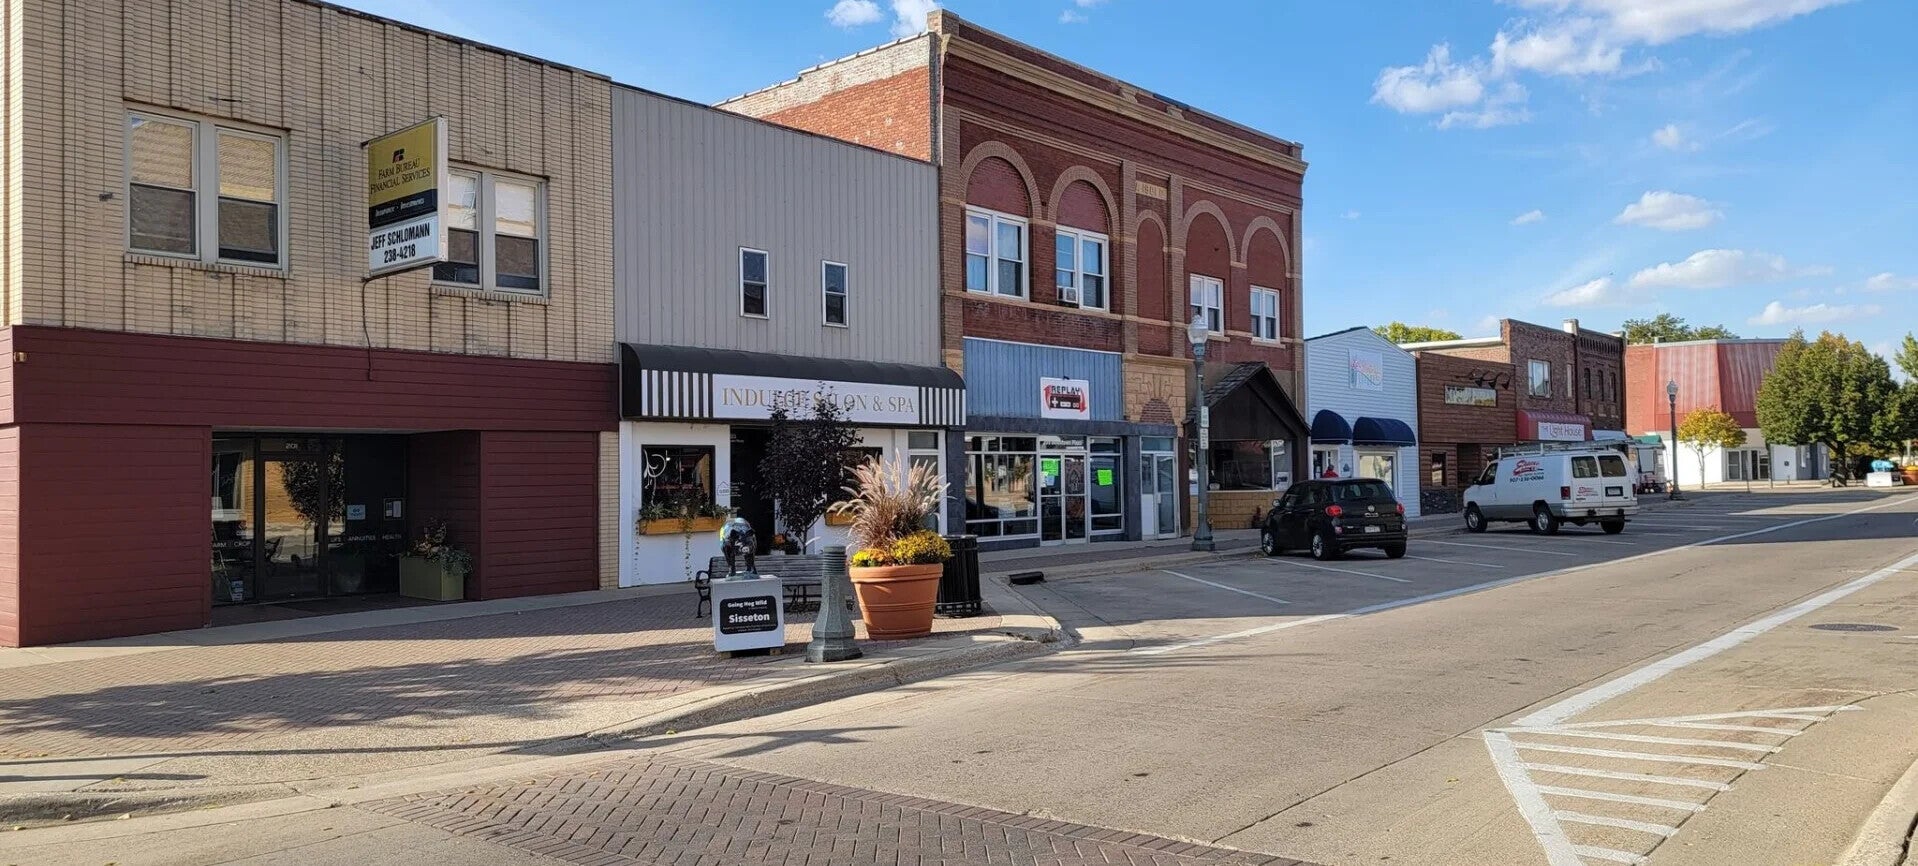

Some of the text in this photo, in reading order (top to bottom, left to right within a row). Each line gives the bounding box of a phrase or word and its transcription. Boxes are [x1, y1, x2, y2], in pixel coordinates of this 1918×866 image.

[378, 157, 420, 180] FARM BUREAU
[370, 166, 431, 195] FINANCIAL SERVICES
[371, 222, 430, 250] JEFF SCHLOMANN
[384, 243, 416, 264] 238-4218
[1051, 385, 1081, 395] REPLAY
[872, 395, 884, 412] &
[888, 396, 915, 413] SPA
[728, 613, 770, 624] Sisseton
